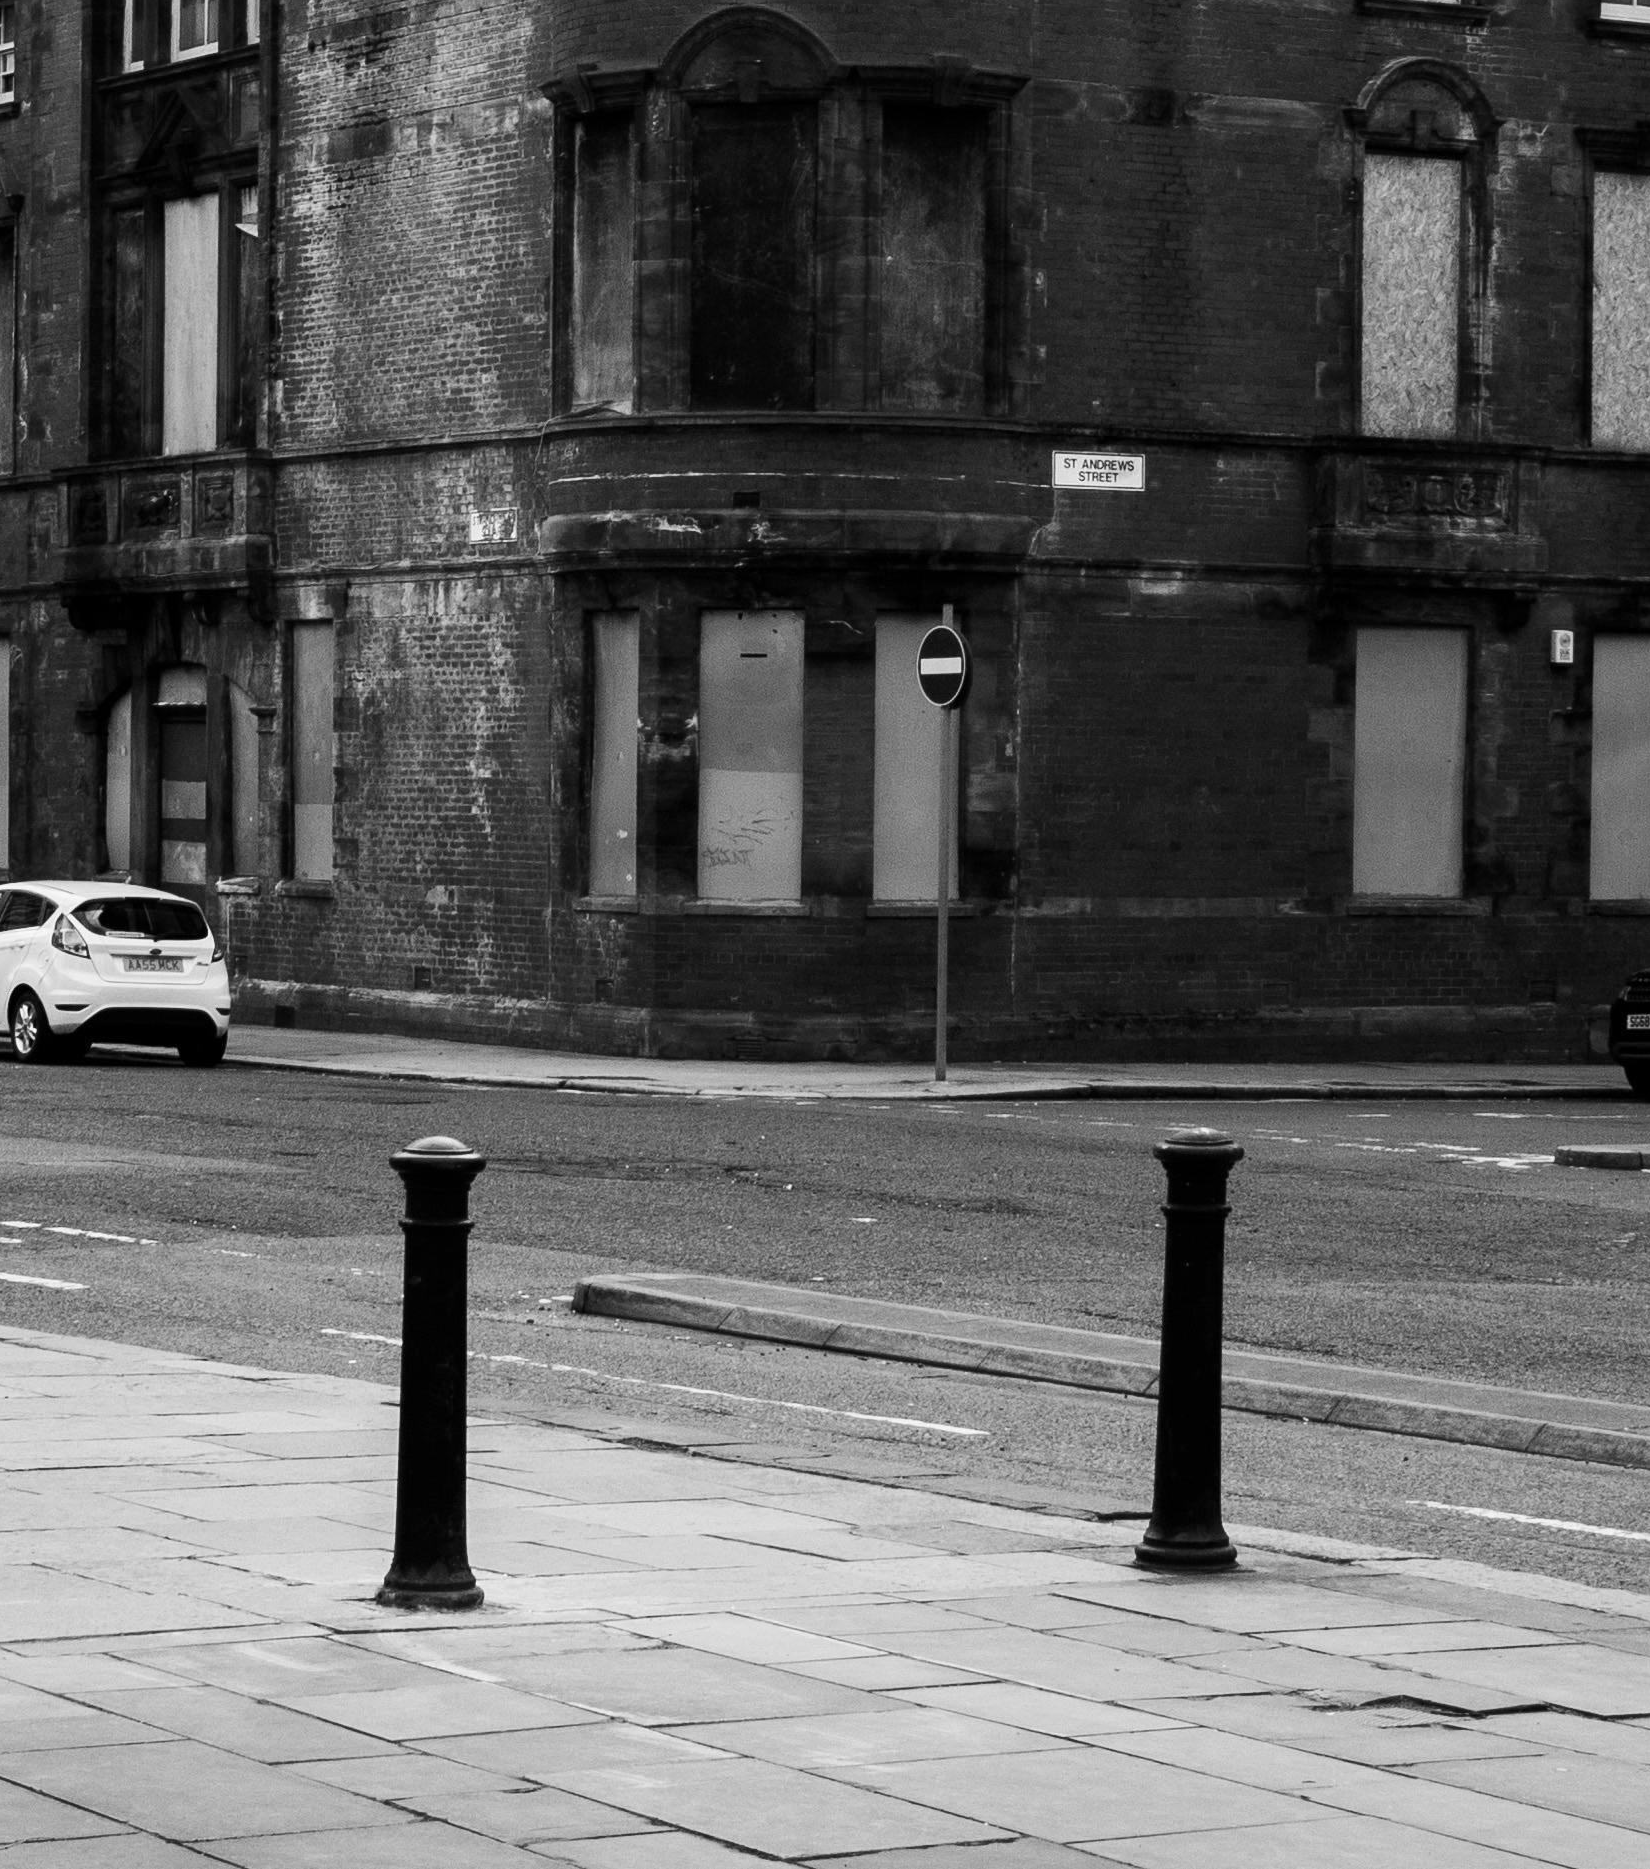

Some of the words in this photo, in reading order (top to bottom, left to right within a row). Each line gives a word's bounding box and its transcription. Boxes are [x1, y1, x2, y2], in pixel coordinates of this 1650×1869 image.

[1063, 458, 1077, 469] ST
[1082, 459, 1135, 472] ANDREWS
[1078, 470, 1119, 483] STREET
